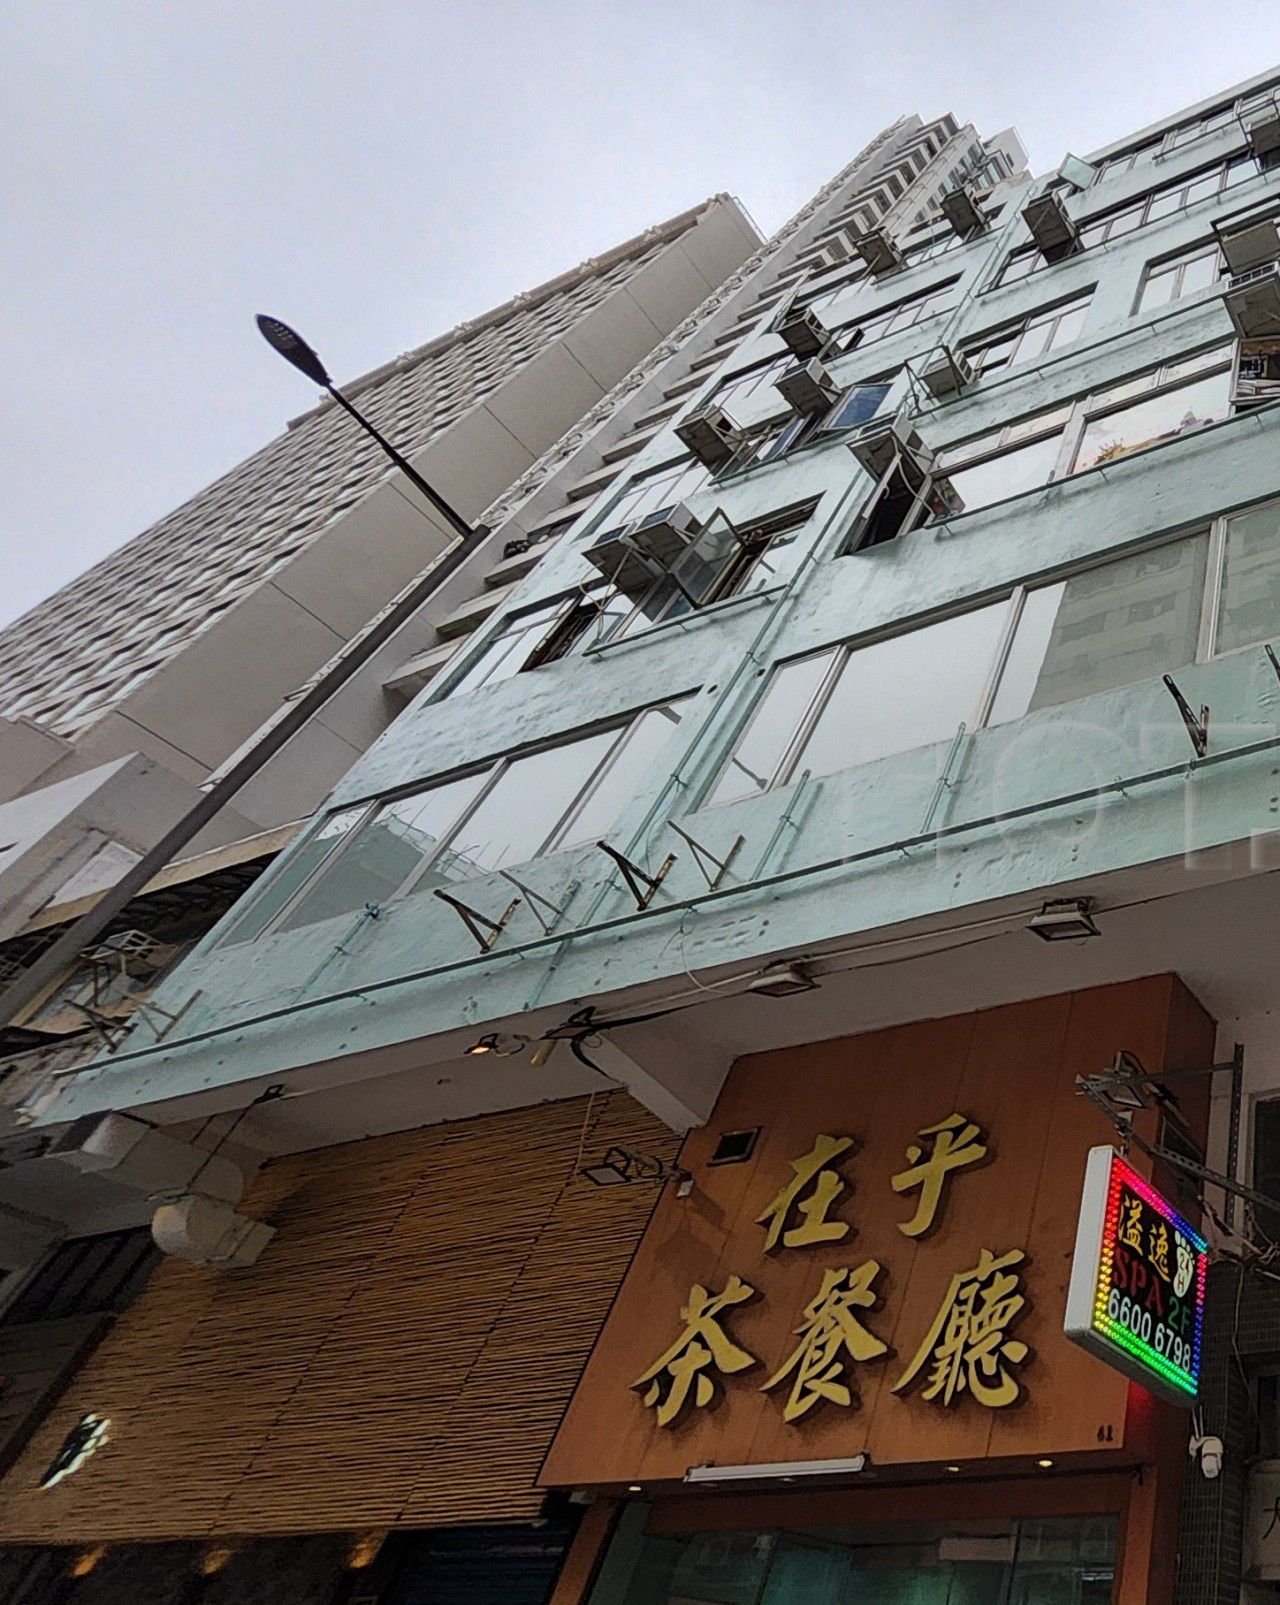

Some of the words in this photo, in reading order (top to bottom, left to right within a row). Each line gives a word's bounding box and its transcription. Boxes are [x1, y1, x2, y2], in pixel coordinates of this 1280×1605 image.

[757, 1111, 987, 1255] 在乎
[1112, 1248, 1163, 1317] SPA
[1167, 1295, 1190, 1335] 2F
[630, 1248, 1028, 1427] 茶餐廳
[1108, 1288, 1151, 1343] 6600
[1154, 1322, 1191, 1373] 6798
